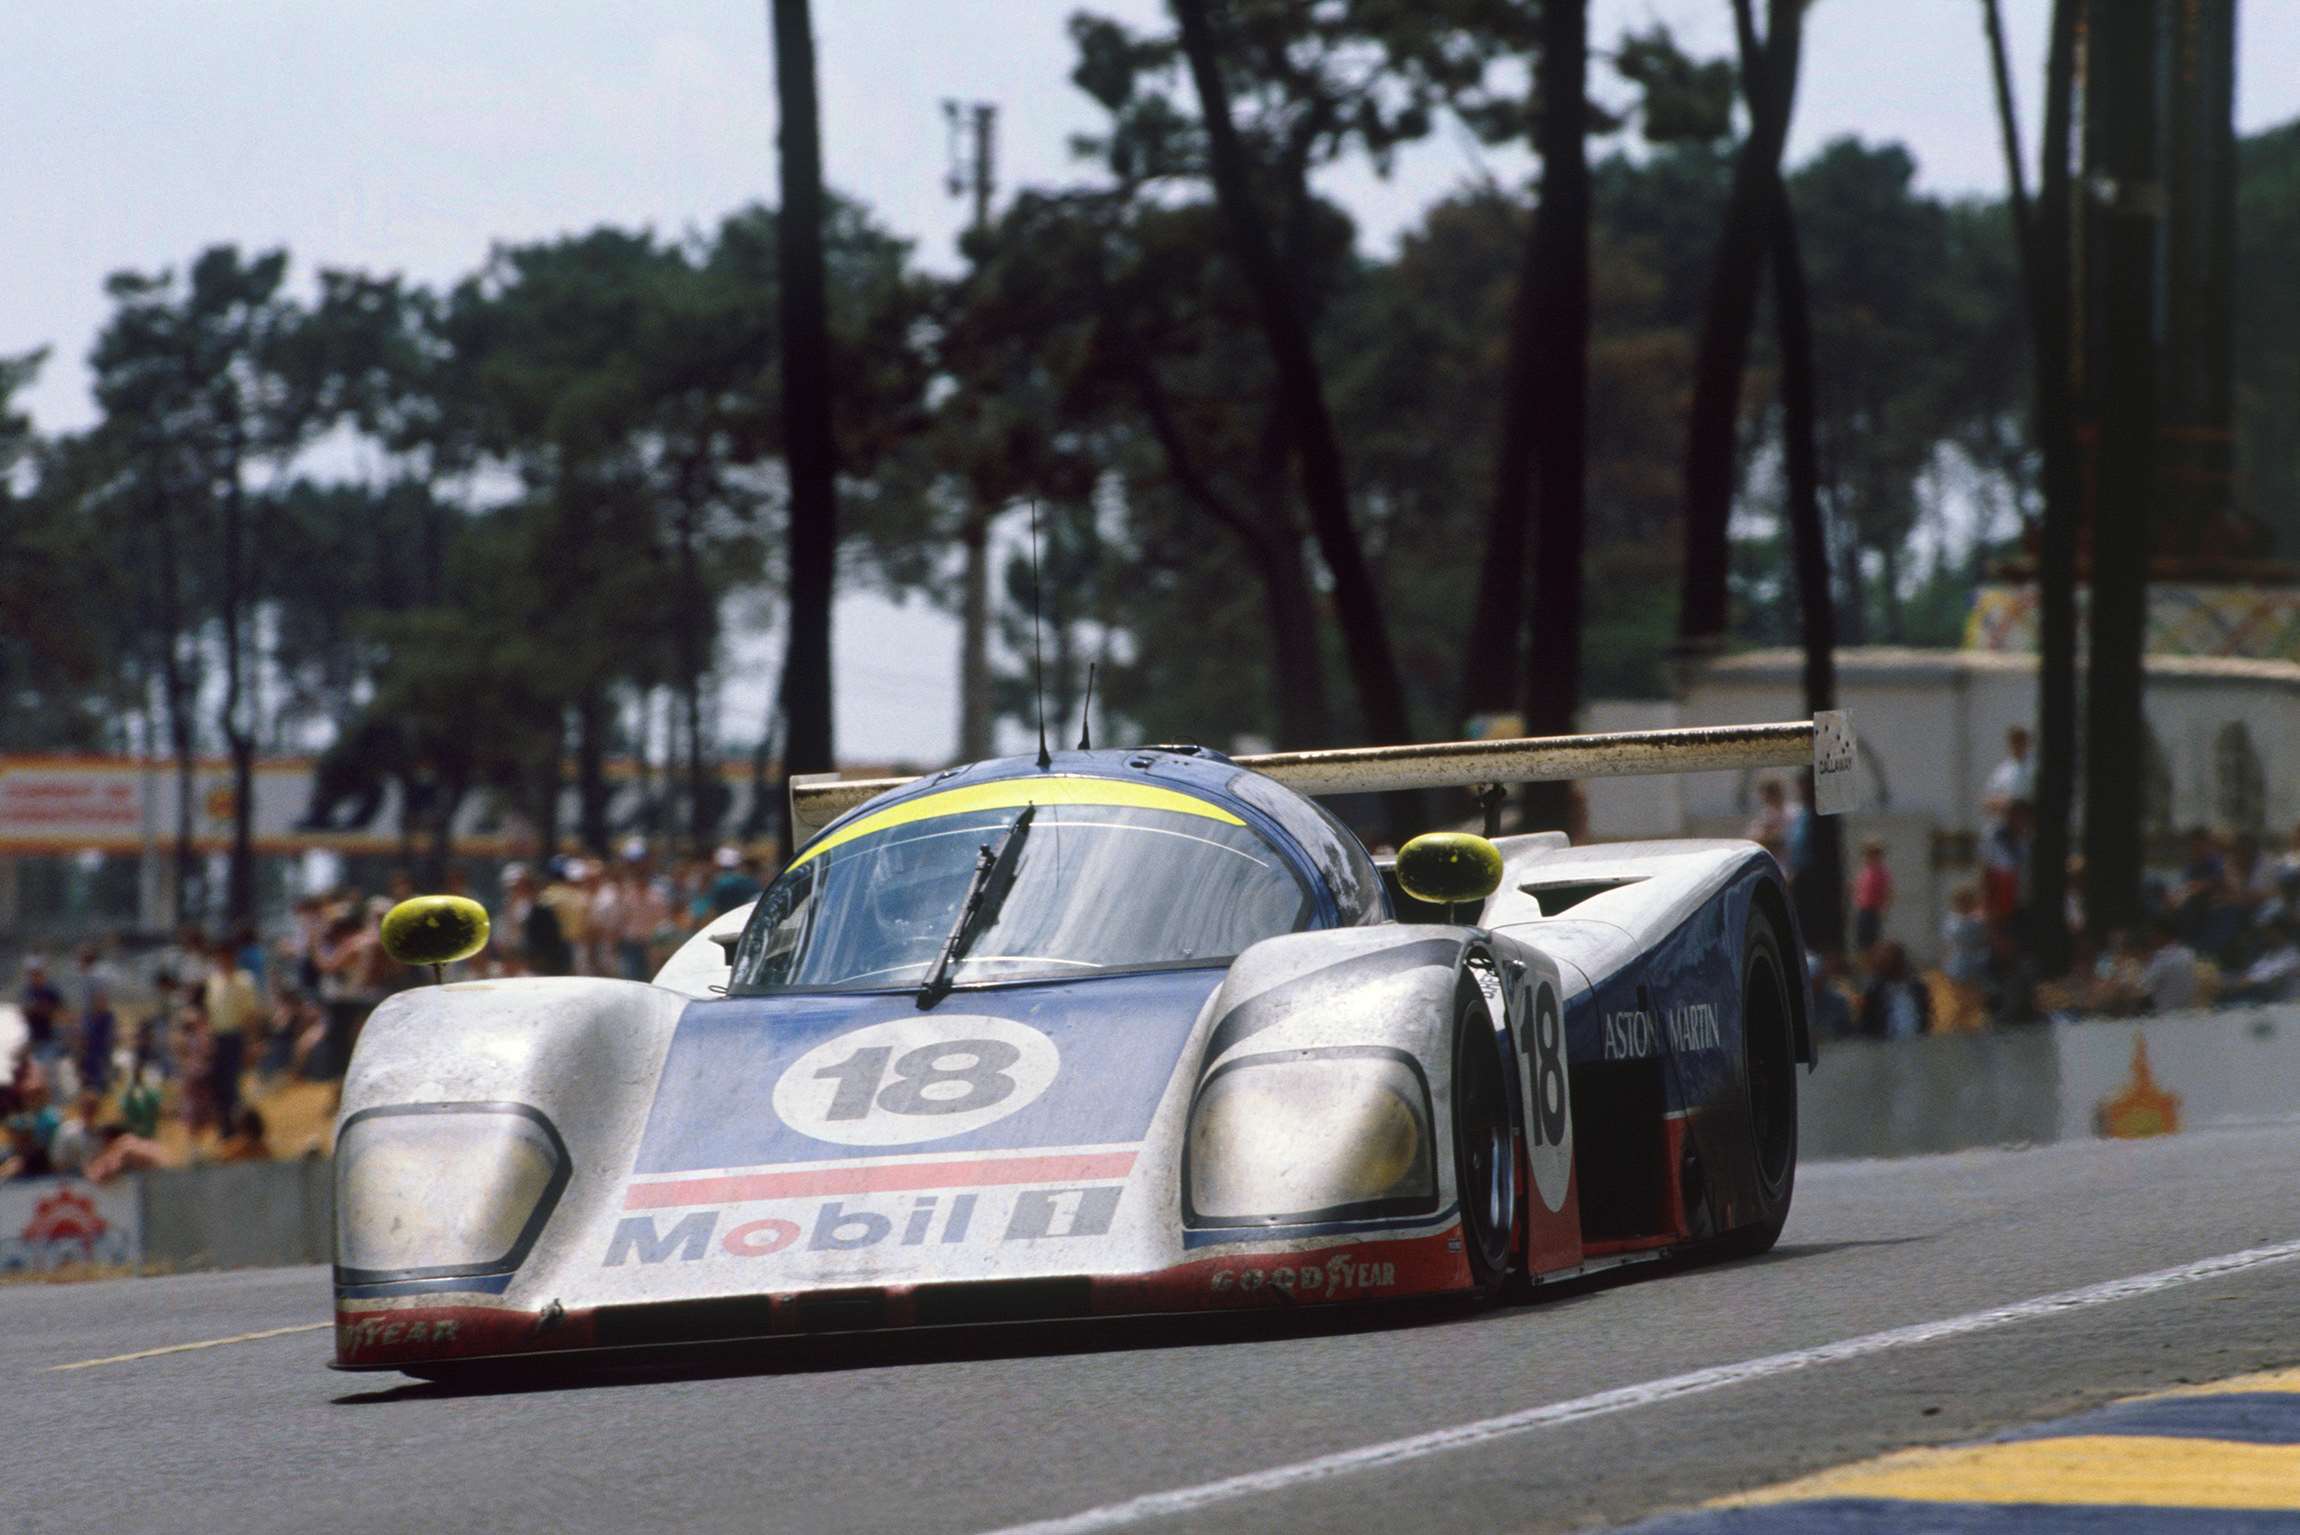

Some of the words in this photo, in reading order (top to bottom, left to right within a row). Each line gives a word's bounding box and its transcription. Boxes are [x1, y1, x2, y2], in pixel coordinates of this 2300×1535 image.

[1520, 981, 1566, 1147] 18
[1604, 1010, 1659, 1060] ASTON
[1668, 1002, 1720, 1052] MARTIN
[812, 1038, 1022, 1121] 18
[602, 1194, 978, 1267] Mobil
[1211, 1254, 1396, 1298] GOODYEAR
